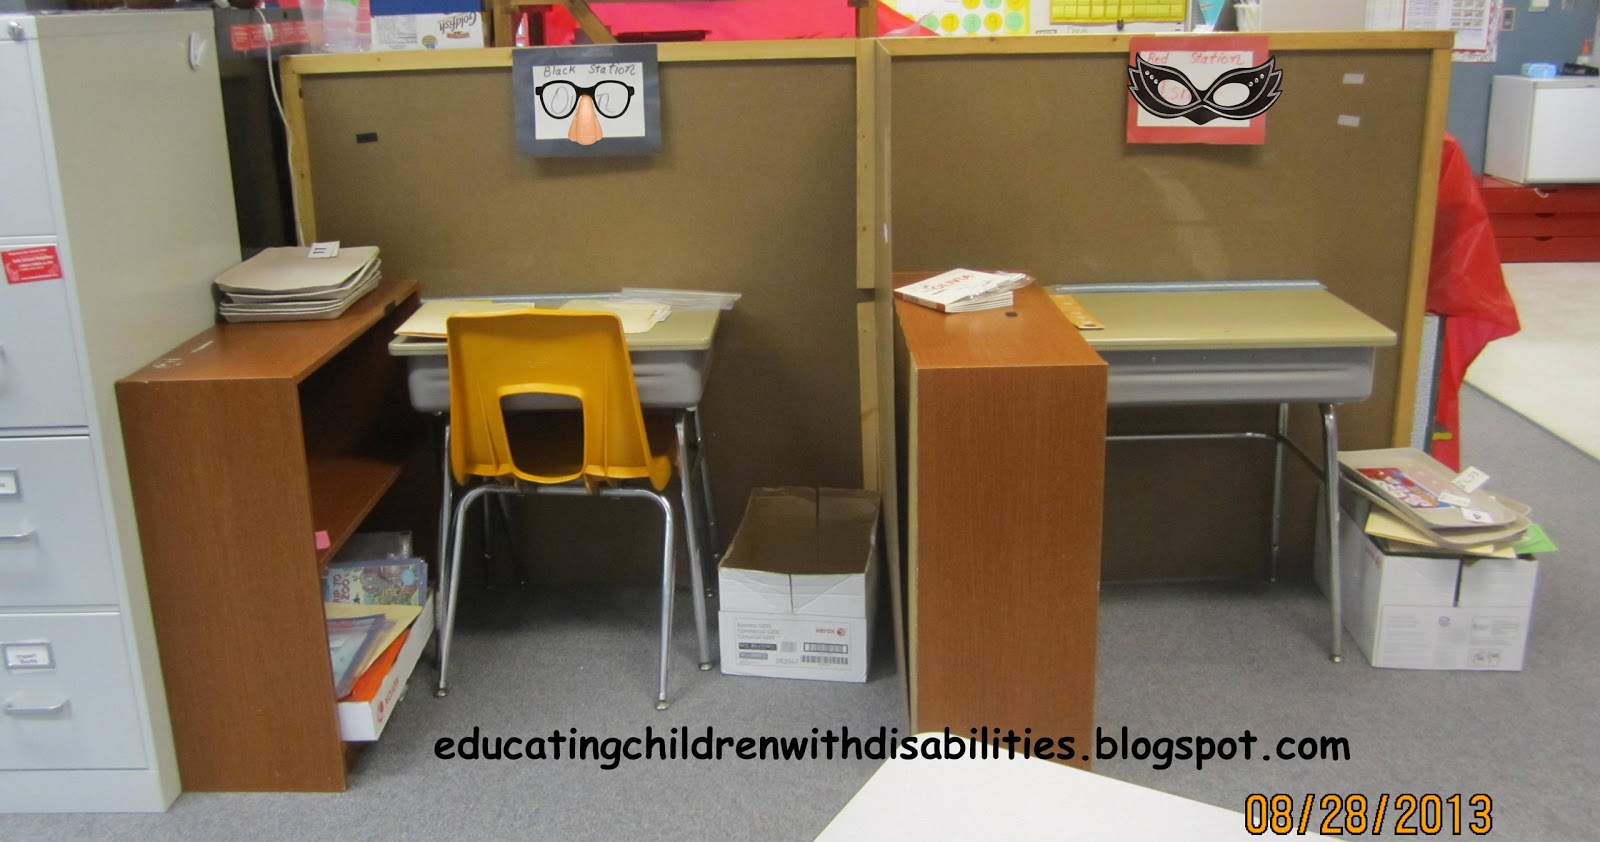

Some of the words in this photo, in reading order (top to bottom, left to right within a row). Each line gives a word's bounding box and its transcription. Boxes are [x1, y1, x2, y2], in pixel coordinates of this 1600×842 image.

[440, 12, 477, 35] Goldfish
[1147, 53, 1169, 64] Red
[1191, 52, 1245, 65] Station
[543, 65, 576, 77] Black
[588, 63, 636, 76] Station
[333, 574, 342, 587] TO
[341, 578, 351, 600] ZOO
